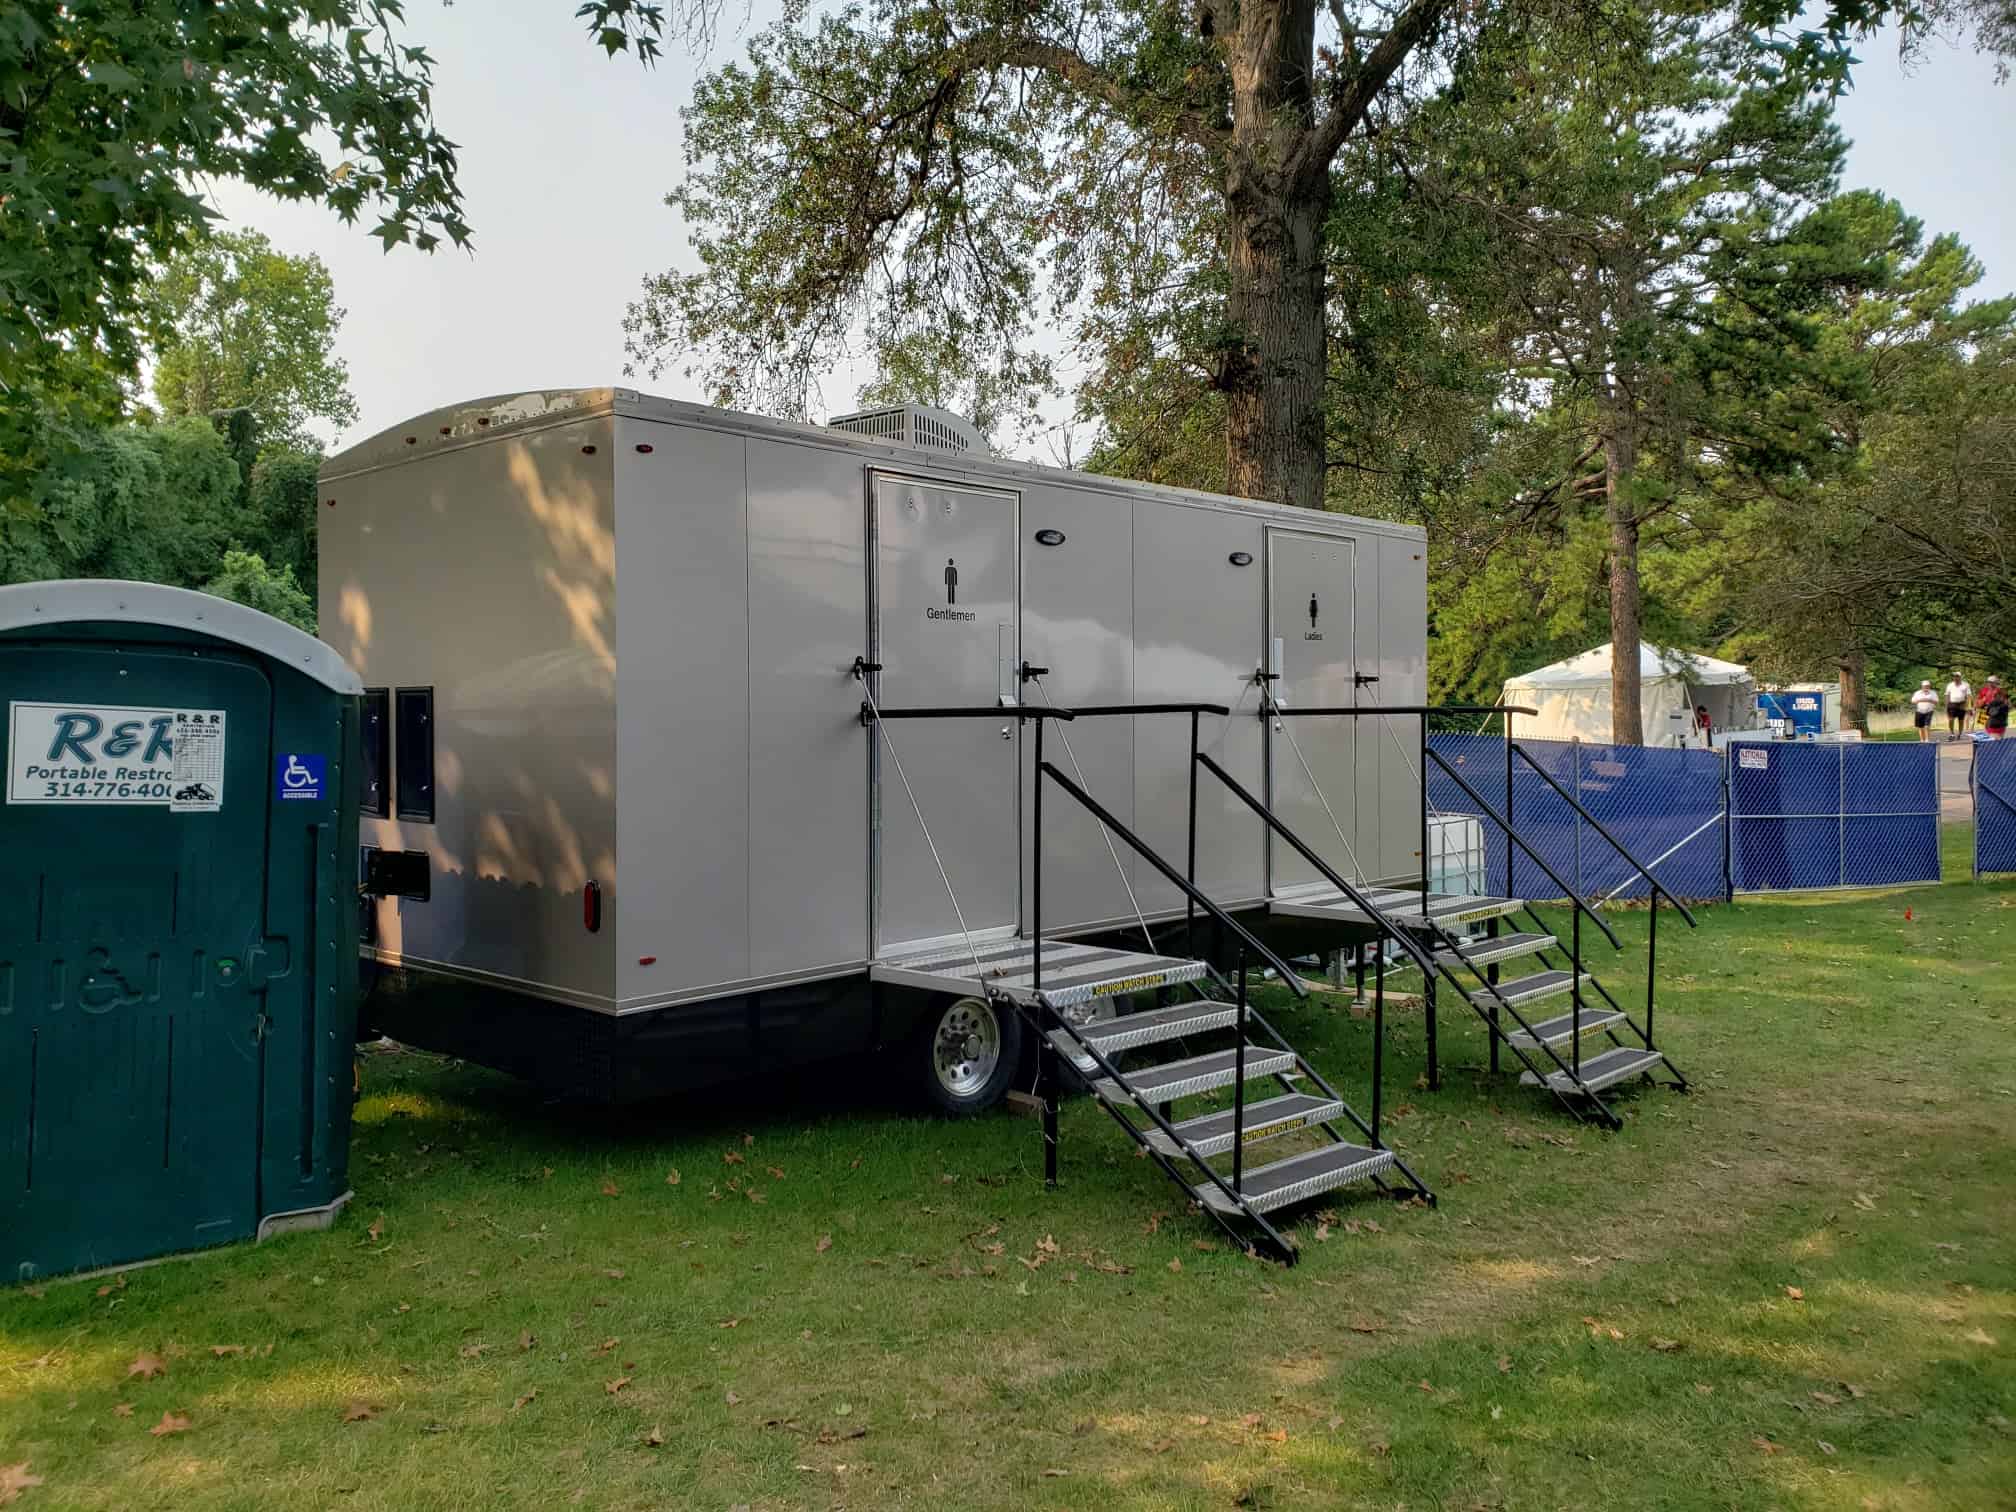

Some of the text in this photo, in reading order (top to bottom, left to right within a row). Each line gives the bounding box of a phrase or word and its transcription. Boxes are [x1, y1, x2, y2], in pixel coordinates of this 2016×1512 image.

[926, 607, 976, 621] Gentlemen
[1304, 631, 1323, 641] Ladies
[1792, 703, 1818, 711] LIGHT
[176, 713, 220, 724] R & R
[26, 765, 108, 780] Portable
[1096, 981, 1124, 993] CAUTION
[1124, 976, 1145, 988] WATCH
